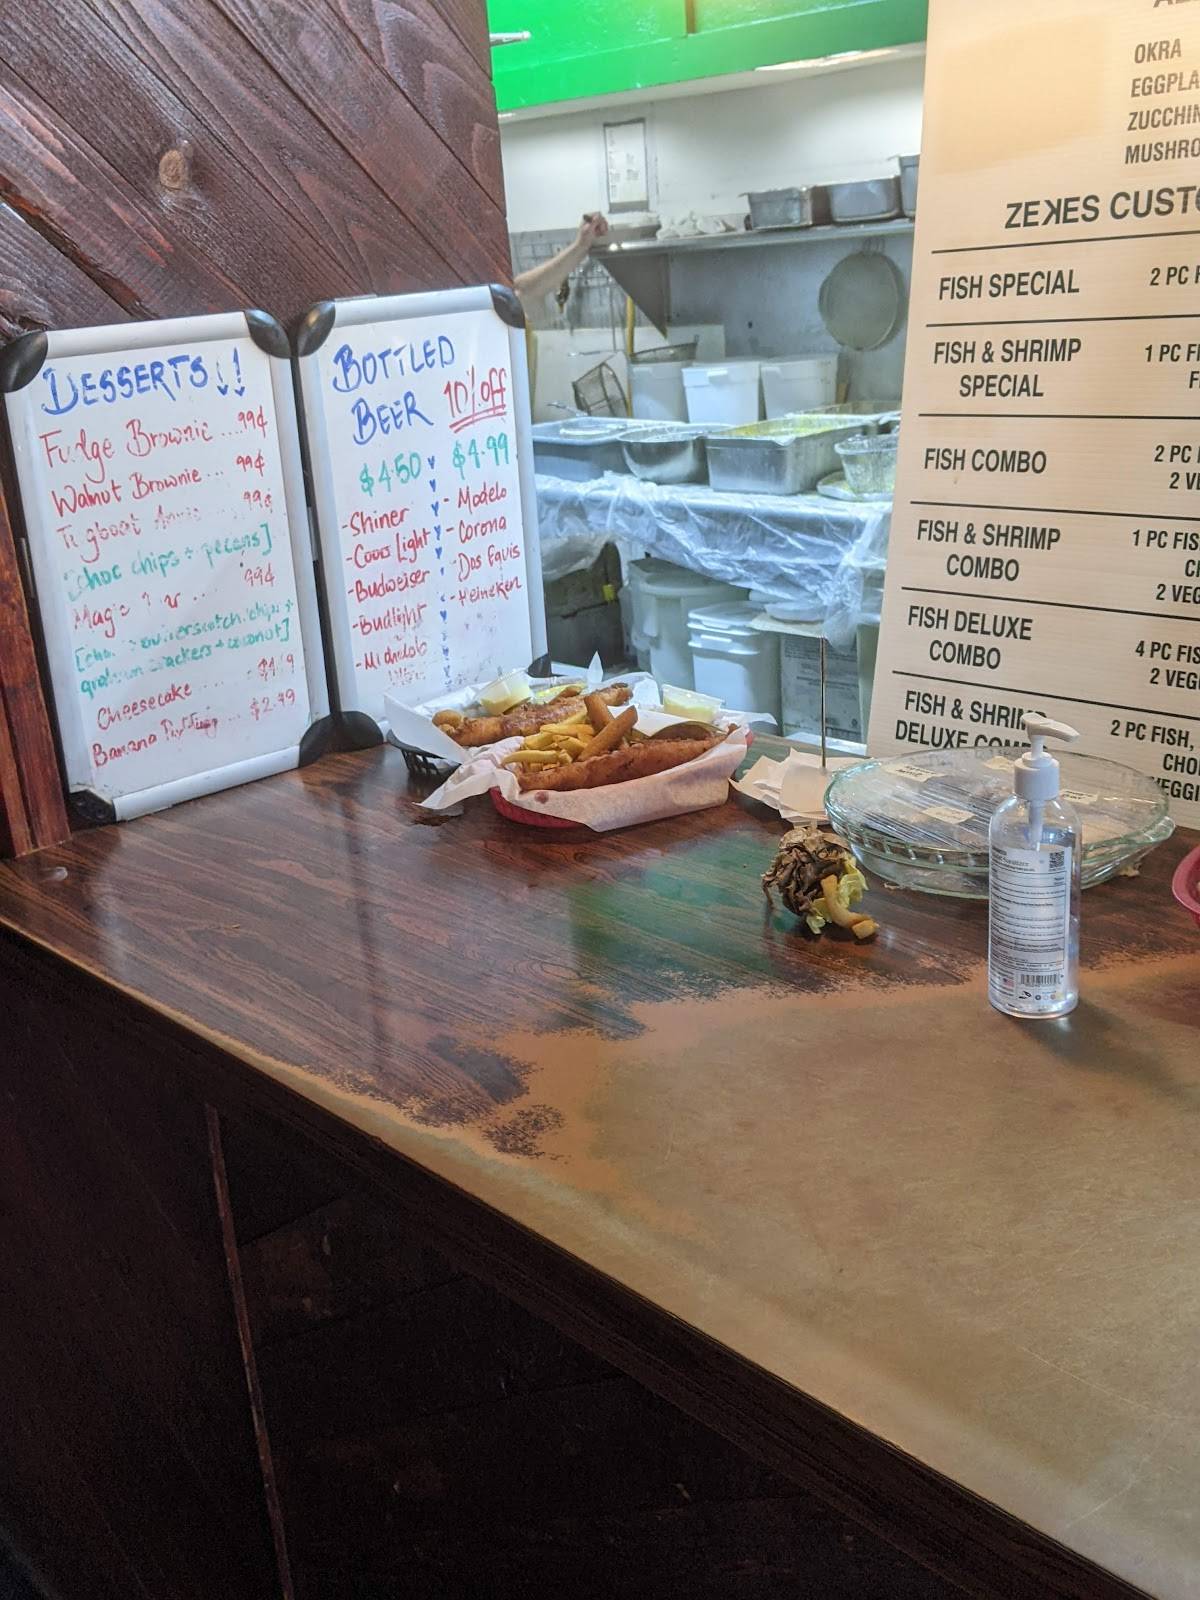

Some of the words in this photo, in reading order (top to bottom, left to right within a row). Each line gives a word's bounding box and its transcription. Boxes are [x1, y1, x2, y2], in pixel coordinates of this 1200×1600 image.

[1134, 38, 1182, 64] OKRA
[1004, 194, 1101, 229] ZEKES
[1110, 185, 1200, 220] CUST
[939, 275, 983, 300] FISH
[988, 269, 1080, 297] SPECIAL
[1150, 268, 1160, 286] 2
[1166, 266, 1189, 285] PC
[333, 335, 455, 393] BOTTLED
[934, 341, 976, 364] FISH
[981, 340, 994, 363] &
[1001, 338, 1081, 362] SHRIMP
[1145, 344, 1152, 362] 1
[1158, 344, 1181, 362] PC
[959, 374, 1044, 398] SPECIAL
[351, 391, 434, 446] BEER
[126, 419, 213, 457] Brownie
[452, 432, 510, 481] $4.99
[924, 448, 965, 470] FISH
[971, 449, 1047, 474] COMBO
[1154, 445, 1165, 462] 2
[1170, 445, 1192, 463] PC
[129, 468, 201, 499] Brownie
[1169, 472, 1180, 489] 2
[396, 527, 431, 564] Light
[917, 519, 958, 543] FISH
[964, 522, 976, 545] &
[983, 524, 1061, 551] SHRIMP
[1132, 529, 1140, 546] 1
[1146, 530, 1168, 548] PC
[946, 554, 1019, 581] COMBO
[1156, 584, 1166, 600] 2
[908, 605, 948, 630] FISH
[954, 610, 1033, 640] DELUXE
[929, 639, 1001, 670] COMBO
[1135, 640, 1145, 657] 4
[1149, 641, 1172, 661] PC
[1150, 667, 1160, 685] 2
[97, 683, 193, 730] Cheesecake
[905, 690, 946, 716] FISH
[951, 699, 964, 720] &
[970, 700, 1047, 731] SHRI
[1111, 719, 1121, 737] 2
[1125, 721, 1147, 741] PC
[1151, 725, 1195, 751] FISH,
